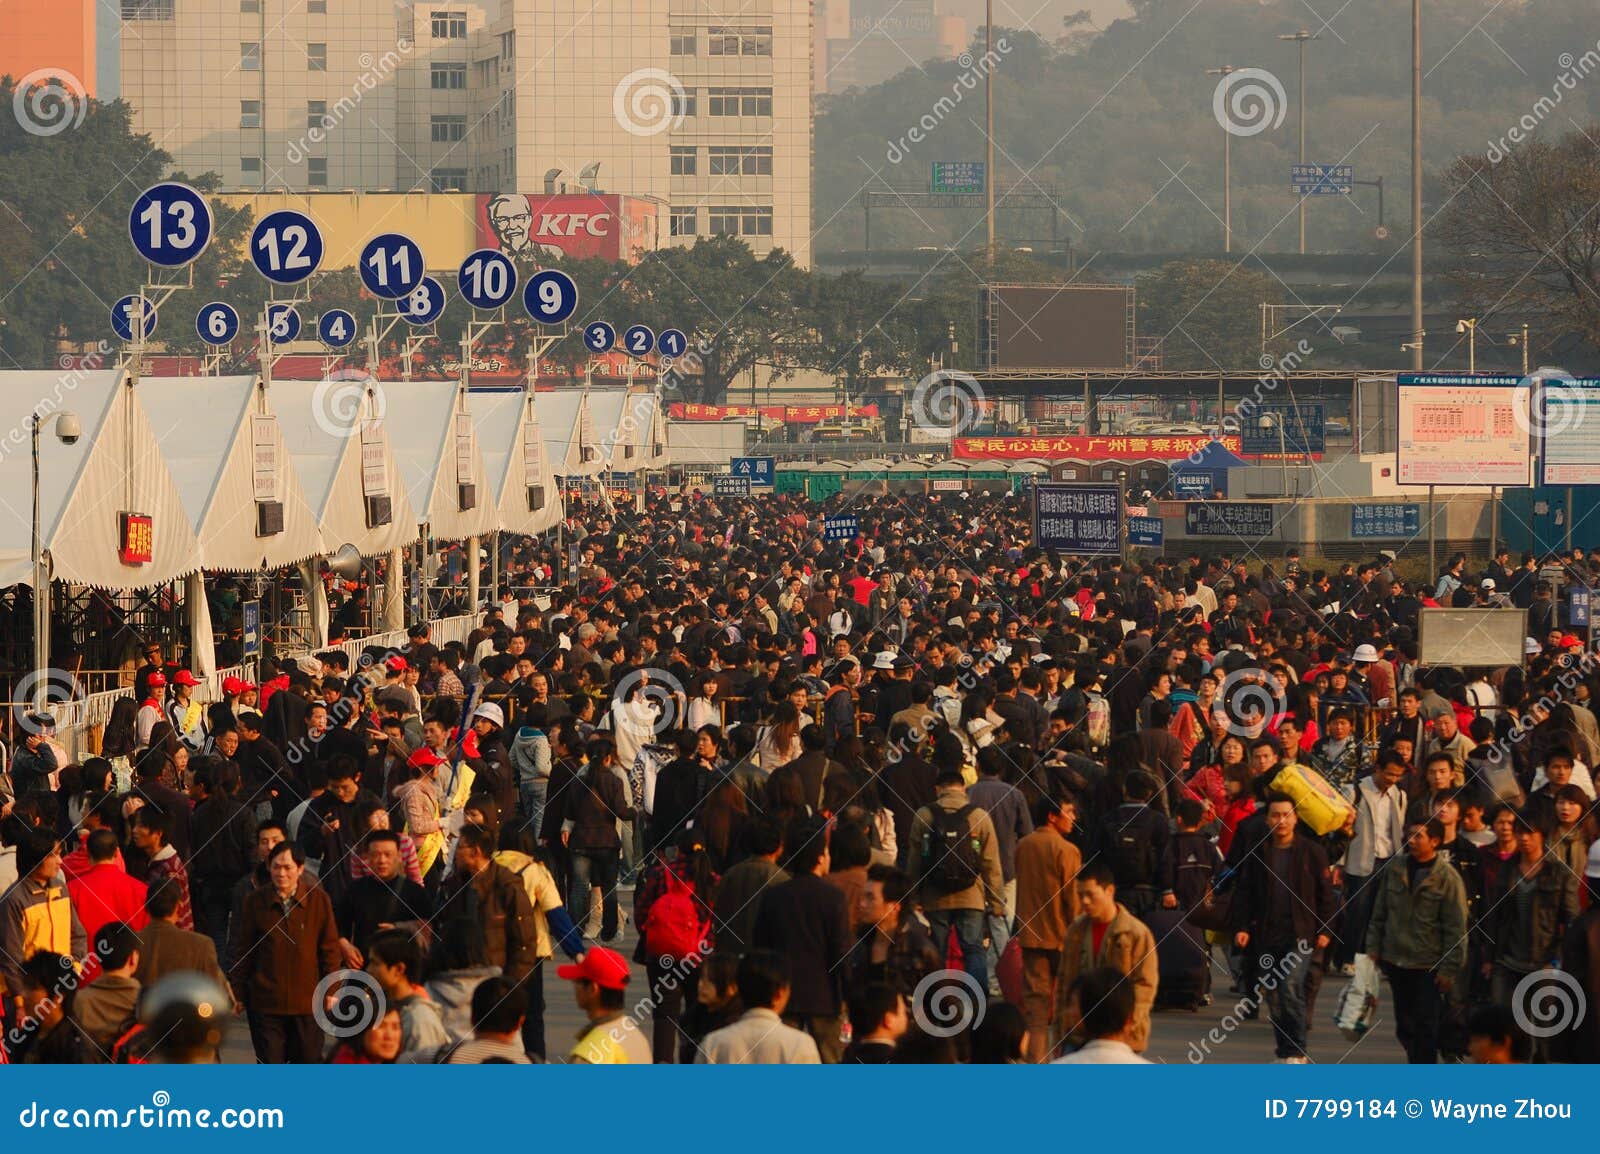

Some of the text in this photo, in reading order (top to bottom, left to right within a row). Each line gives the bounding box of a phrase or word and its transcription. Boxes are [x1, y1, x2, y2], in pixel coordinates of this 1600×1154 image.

[140, 200, 196, 249] 13
[536, 213, 610, 236] KFC
[258, 225, 311, 271] 12
[369, 245, 411, 286] 11
[465, 258, 508, 299] 10
[410, 284, 432, 316] 8
[538, 280, 562, 314] 9
[208, 310, 227, 338] 6
[272, 311, 290, 337] 5
[329, 316, 347, 341] 4
[592, 327, 607, 348] 3
[633, 331, 646, 351] 2
[667, 334, 678, 353] 1
[739, 460, 768, 474] 公厕
